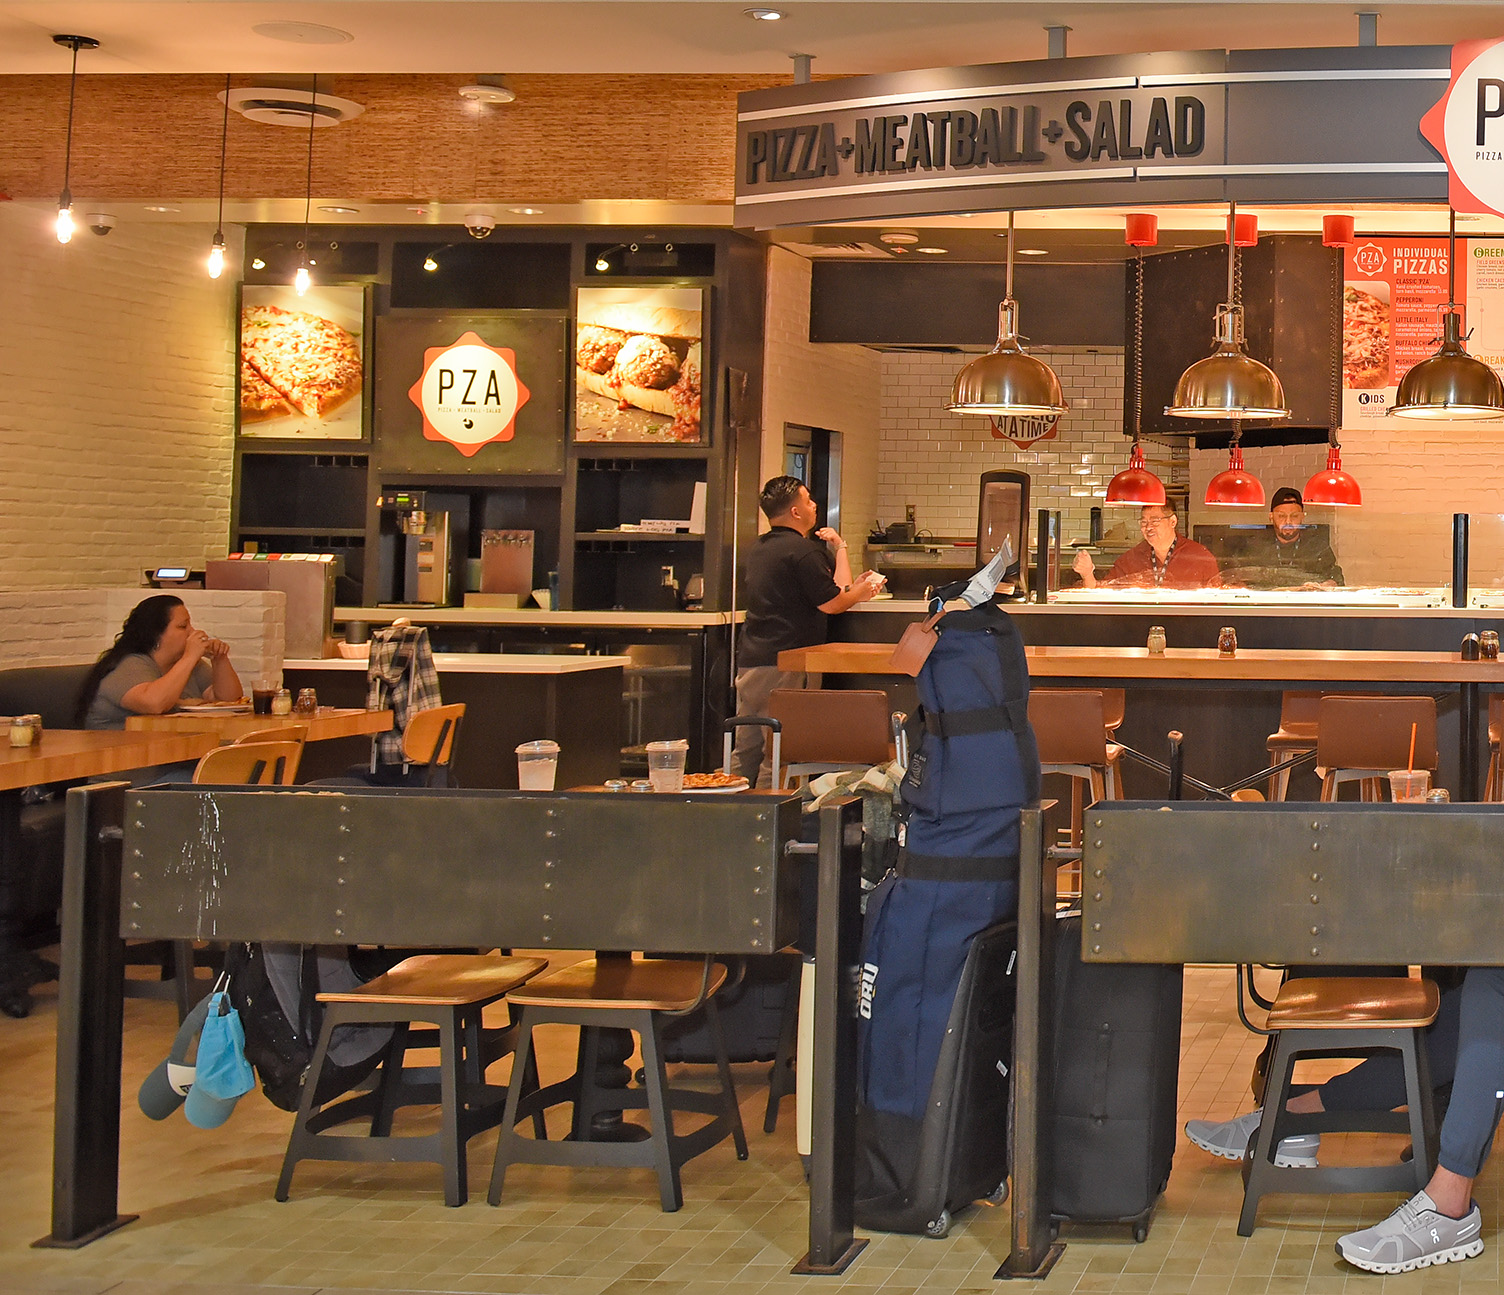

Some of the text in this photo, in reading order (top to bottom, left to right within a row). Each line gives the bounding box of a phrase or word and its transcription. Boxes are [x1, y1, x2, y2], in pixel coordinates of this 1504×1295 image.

[1475, 151, 1503, 161] PIZZA
[1360, 251, 1380, 263] PZA
[1393, 247, 1449, 258] INDIVIDUAL
[1393, 258, 1448, 275] PIZZAS
[438, 368, 501, 406] PZA
[1358, 393, 1385, 404] KIDS
[1019, 419, 1049, 438] TIME
